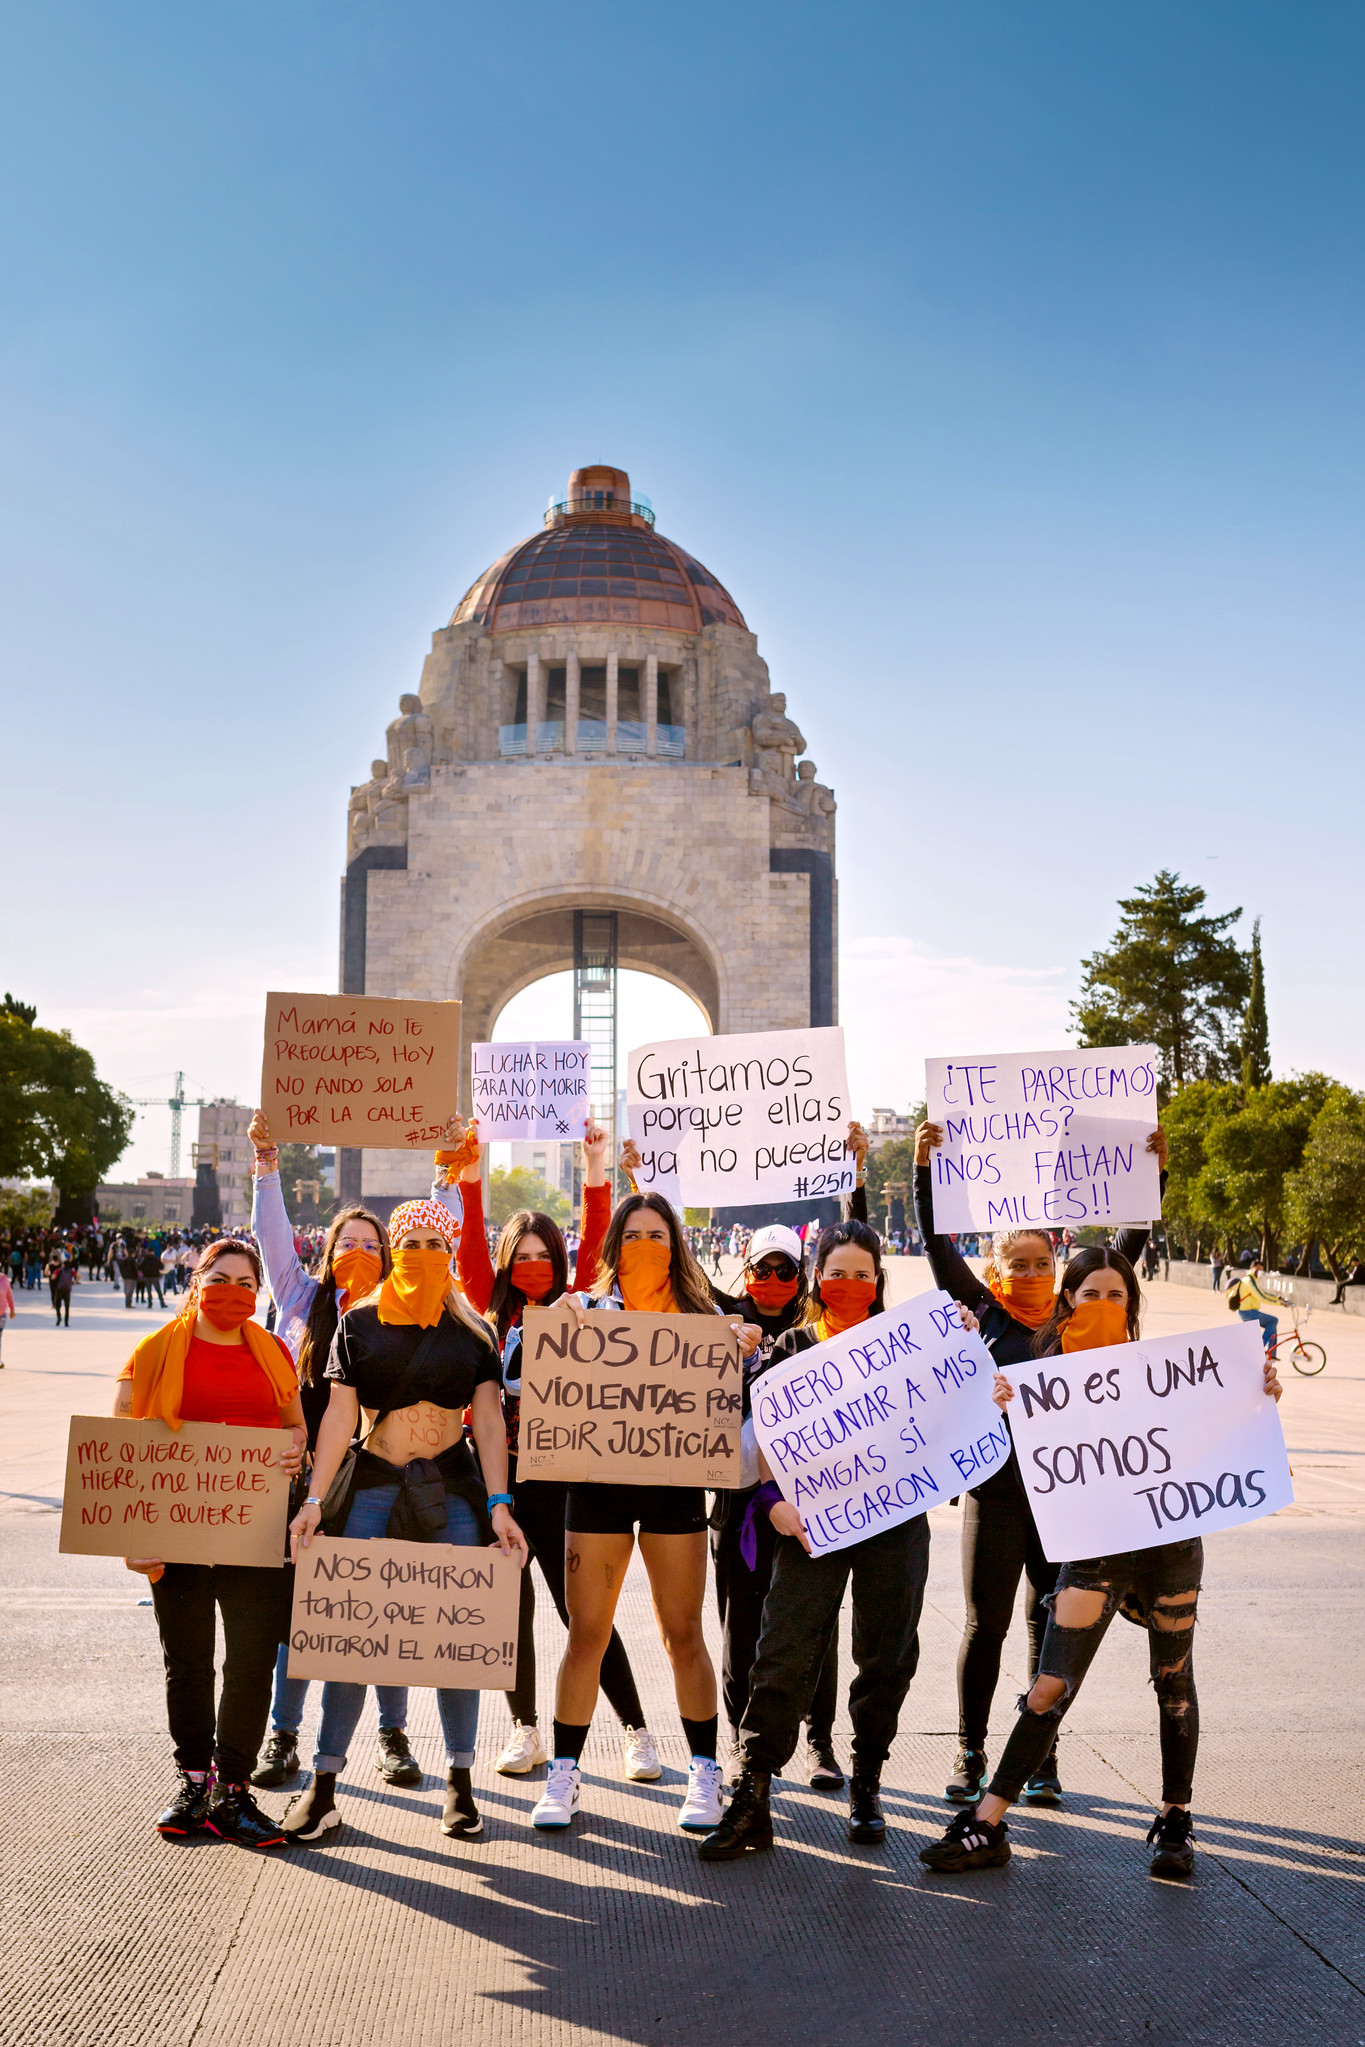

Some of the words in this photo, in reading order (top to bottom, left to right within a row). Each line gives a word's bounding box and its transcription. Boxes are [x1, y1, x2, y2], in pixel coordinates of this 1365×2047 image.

[278, 1007, 356, 1034] Mamá
[369, 1019, 394, 1035] NO
[403, 1018, 422, 1036] TE
[275, 1040, 380, 1064] PREOCUPES,
[475, 1052, 548, 1074] LUCHAR
[555, 1053, 588, 1071] HOY
[276, 1076, 304, 1095] NO
[315, 1077, 363, 1095] ANDO
[373, 1077, 413, 1093] SOLA
[472, 1077, 507, 1096] PARA
[512, 1078, 535, 1097] NO
[540, 1079, 587, 1096] MORIR
[637, 1050, 813, 1100] Gritamos
[943, 1065, 997, 1105] ¿TE
[1022, 1062, 1154, 1102] PARECEMOS
[287, 1105, 316, 1127] POR
[331, 1106, 352, 1123] LA
[477, 1100, 558, 1121] MAÑANA
[643, 1104, 743, 1143] porque
[768, 1094, 841, 1125] ellas
[947, 1105, 1074, 1144] MUCHAS?
[642, 1150, 677, 1182] ya
[701, 1148, 737, 1172] no
[937, 1153, 1001, 1184] ¡NOS
[1035, 1144, 1132, 1184] FALTAN
[988, 1181, 1110, 1224] MILES!!
[535, 1323, 638, 1367] NOS
[650, 1328, 739, 1379] DICEN
[760, 1360, 843, 1427] QUIERO
[849, 1323, 922, 1379] DEJAR
[929, 1303, 963, 1337] DE
[1147, 1346, 1224, 1397] UNA
[392, 1407, 420, 1423] NO
[528, 1376, 696, 1415] VIOLENTAS
[707, 1389, 742, 1417] POR
[770, 1385, 897, 1473] PREGUNTAR
[906, 1378, 926, 1408] A
[933, 1350, 977, 1394] MIS
[205, 1445, 231, 1463] NO
[527, 1418, 602, 1457] PEDIR
[608, 1421, 734, 1458] JUSTICIA
[795, 1445, 886, 1507] AMIGAS
[805, 1466, 939, 1547] LLEGARON
[950, 1422, 1007, 1480] BIEN
[82, 1502, 111, 1525] NO
[124, 1500, 159, 1524] ME
[170, 1501, 253, 1525] QUIERE
[314, 1554, 371, 1581] NOS
[299, 1590, 379, 1628] tanto,
[384, 1602, 426, 1624] QUE
[437, 1605, 485, 1625] NOS
[399, 1639, 424, 1660] EL
[434, 1642, 514, 1666] MIEDO!!
